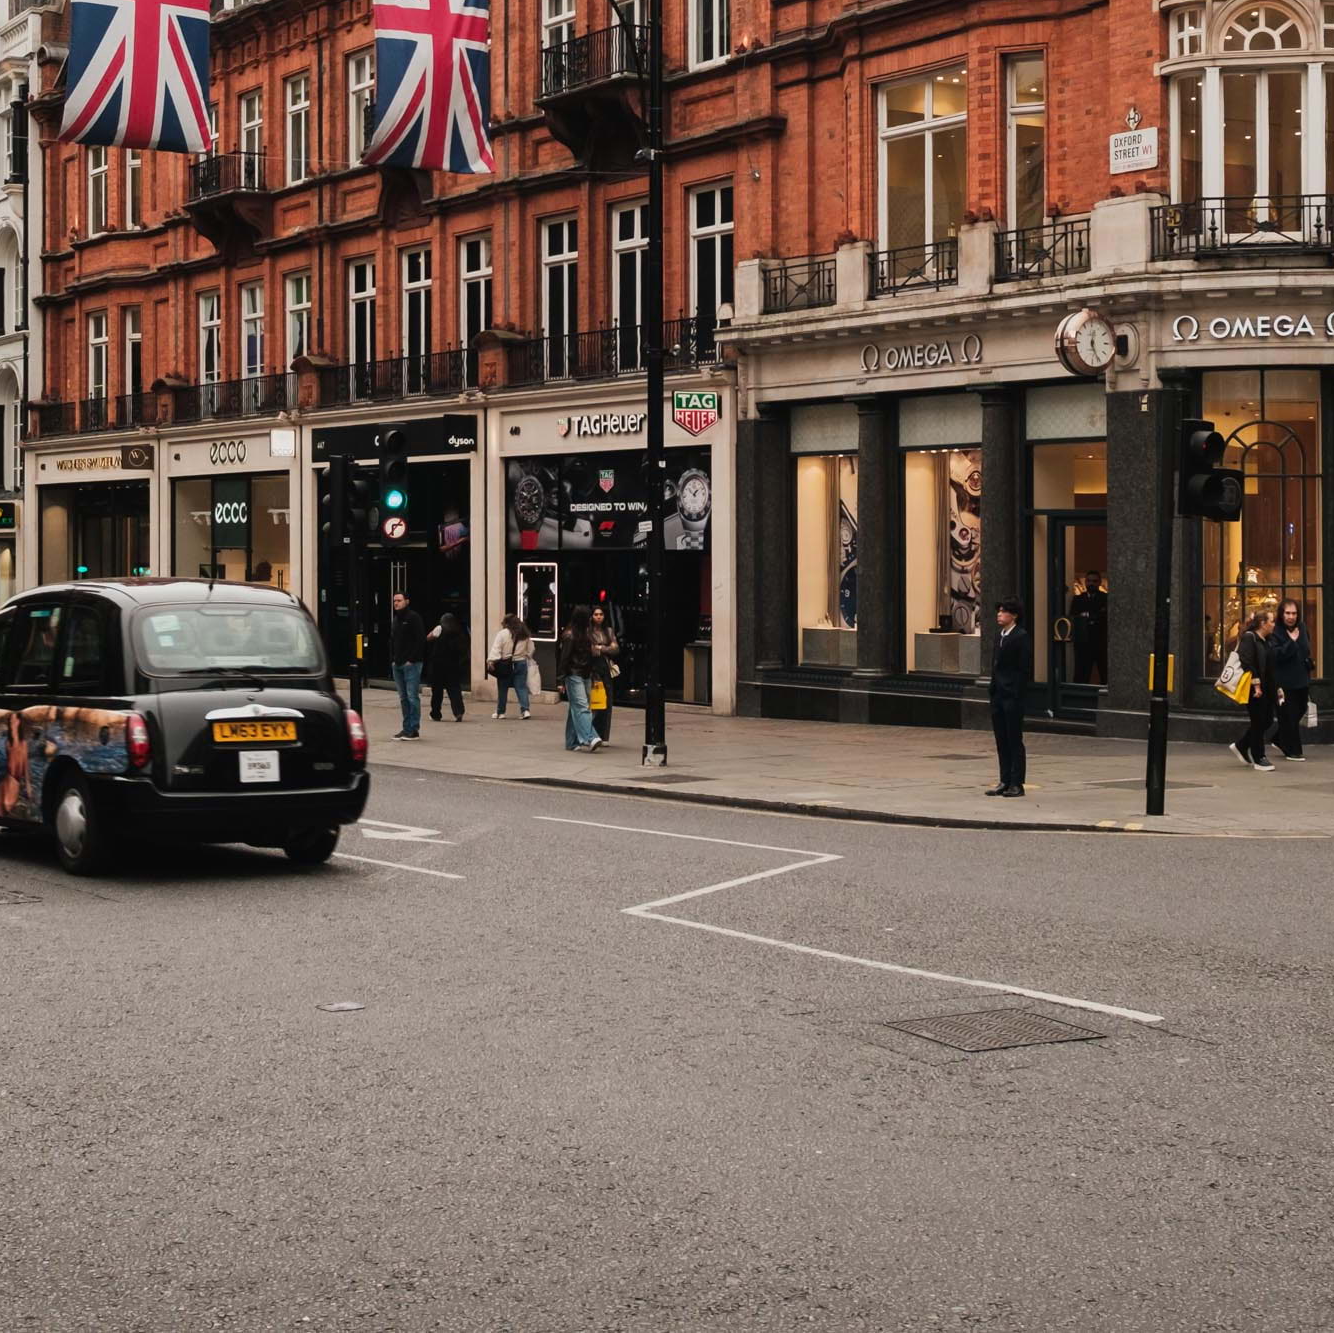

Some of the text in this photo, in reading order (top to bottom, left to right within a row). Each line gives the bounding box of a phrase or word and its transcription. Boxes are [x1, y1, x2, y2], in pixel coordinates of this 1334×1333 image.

[1114, 134, 1142, 148] OXFORD
[1114, 145, 1152, 160] STREET W1
[1209, 314, 1315, 339] OMEGA
[885, 340, 954, 370] OMEGA
[677, 393, 715, 408] TAG
[676, 410, 716, 432] HEUER
[448, 435, 474, 447] dyson
[210, 440, 247, 465] ecco
[570, 502, 644, 512] DESIGNED TO WIN
[262, 723, 290, 738] EYX
